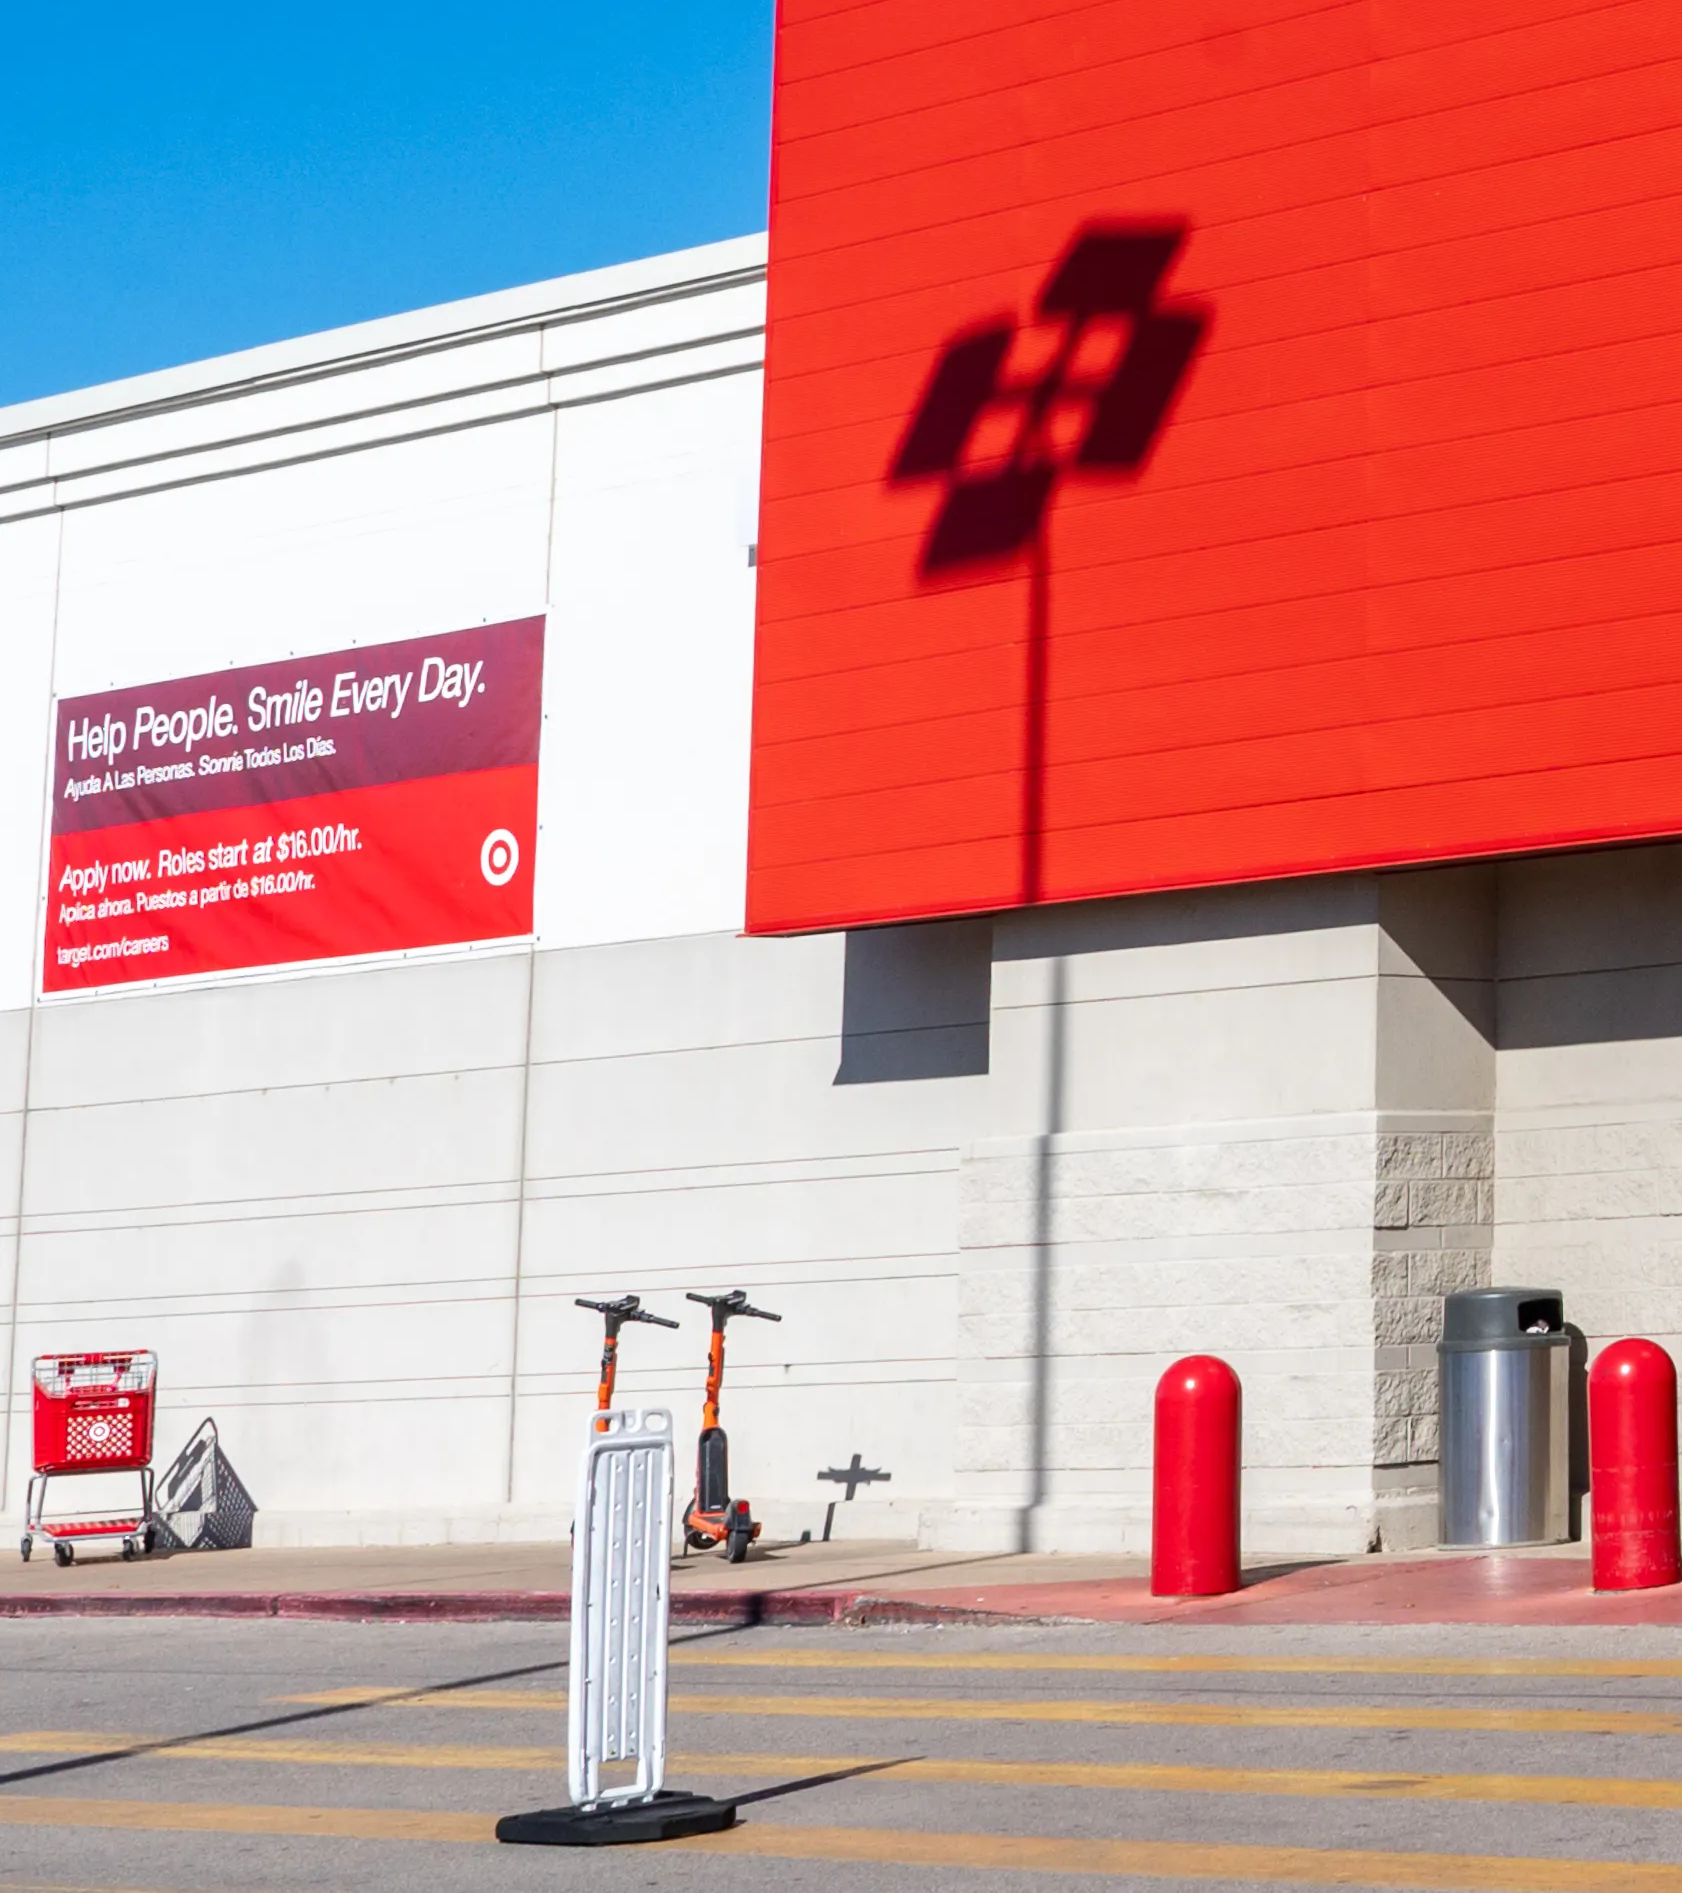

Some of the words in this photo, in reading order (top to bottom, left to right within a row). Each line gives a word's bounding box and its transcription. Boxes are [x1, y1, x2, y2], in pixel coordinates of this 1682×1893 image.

[68, 713, 126, 766] Help
[132, 695, 239, 753] People.
[247, 679, 324, 732] Smile
[329, 671, 414, 719] Every
[417, 656, 486, 708] Day.
[64, 775, 101, 802] Ayuda
[102, 772, 114, 792] A
[115, 770, 136, 790] Las
[136, 761, 196, 786] Personas.
[244, 747, 282, 770] Todos
[282, 742, 305, 764] Los
[306, 735, 337, 758] Días.
[58, 859, 109, 897] Apply
[111, 859, 152, 884] now.
[157, 846, 205, 878] Roles
[208, 838, 249, 870] start
[252, 835, 274, 865] at
[276, 823, 362, 863] $16.00/hr.
[97, 896, 134, 919] ahora.
[136, 889, 187, 913] Puestos
[188, 889, 198, 906] a
[200, 880, 232, 909] partir
[233, 878, 249, 899] de
[250, 869, 316, 898] $16.00/hr.
[57, 935, 169, 968] target.com/careers
